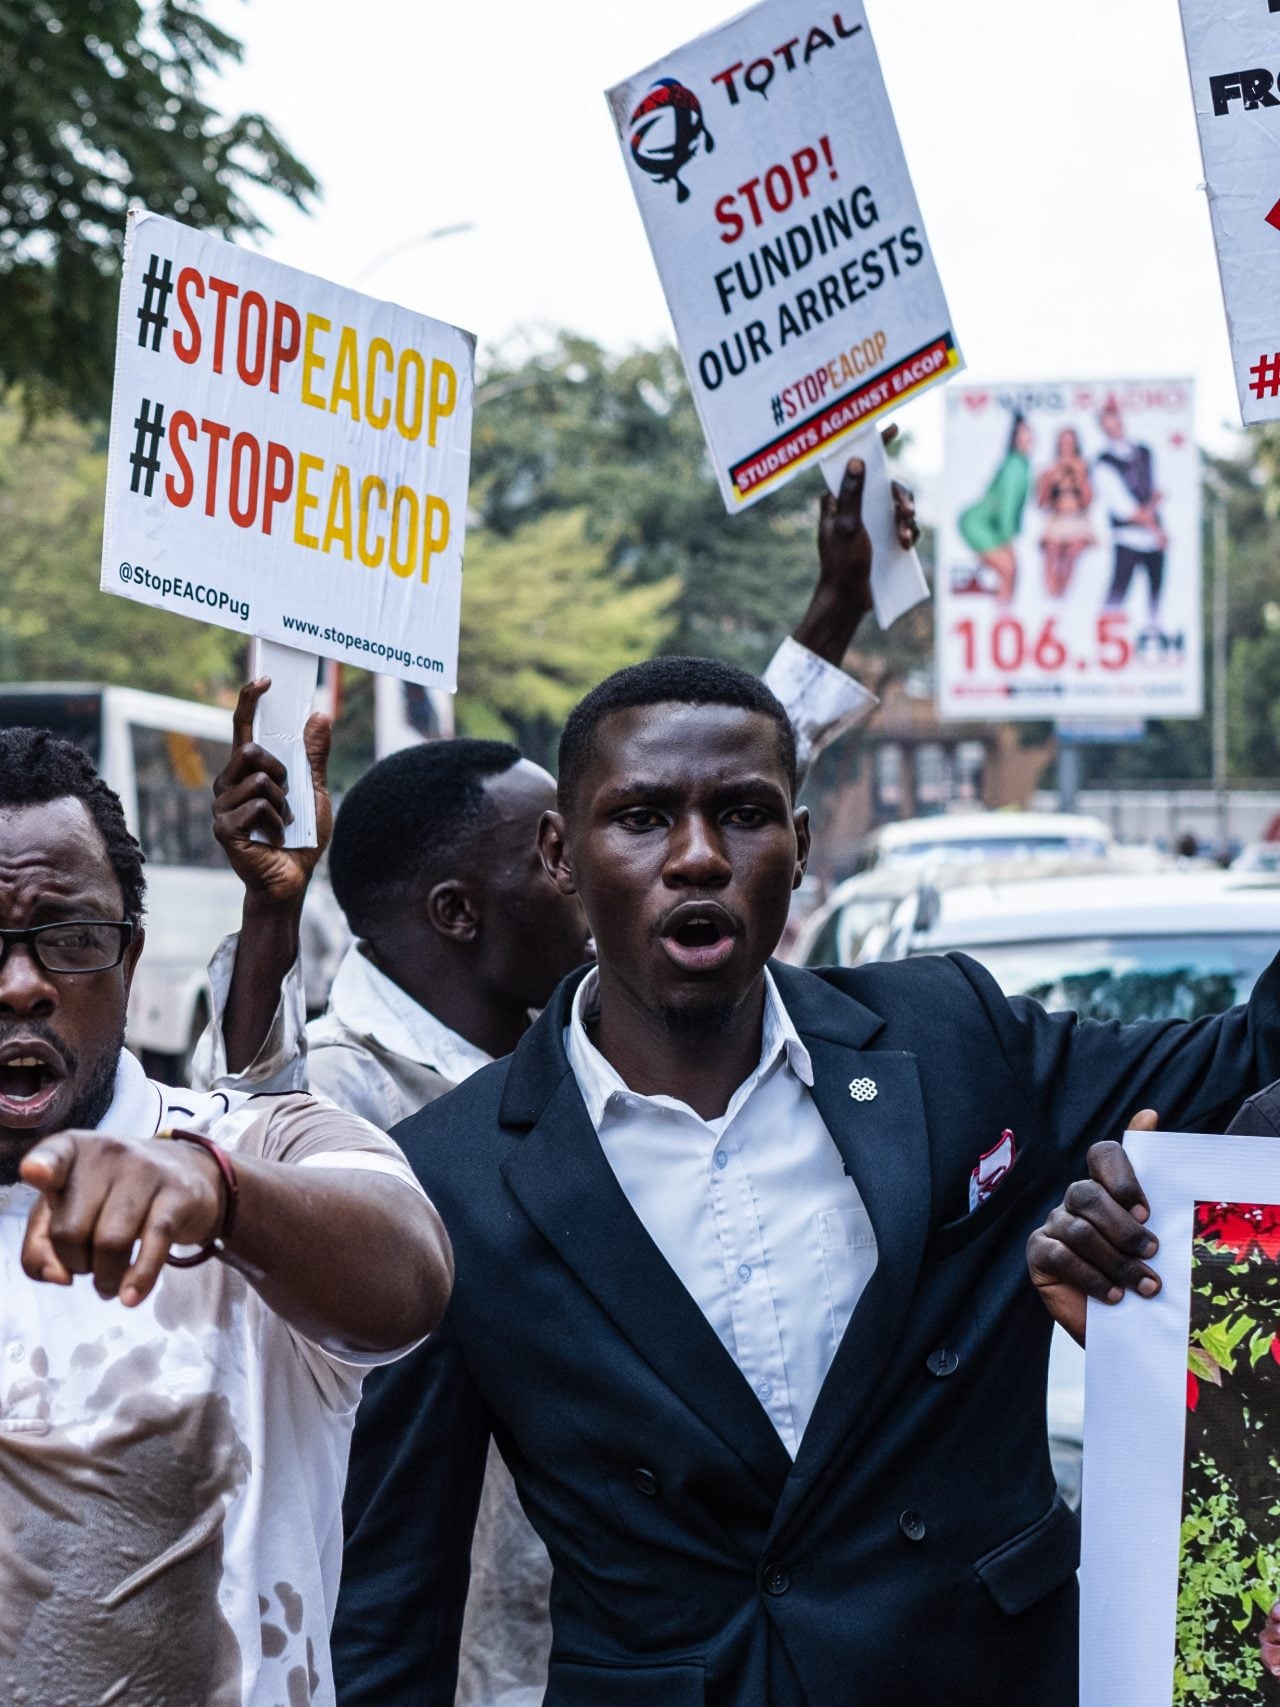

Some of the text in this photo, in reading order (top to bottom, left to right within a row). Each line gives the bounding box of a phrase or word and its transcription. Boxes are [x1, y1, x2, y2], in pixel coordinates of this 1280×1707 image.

[711, 14, 862, 105] TOTAL
[1209, 68, 1280, 117] FR
[714, 135, 839, 245] STOP!
[714, 185, 880, 315] FUNDING
[137, 254, 457, 448] #STOPEACOP
[698, 226, 924, 392] OUR ARRESTS
[736, 350, 946, 492] STUDENTS AGAINST EACOP
[771, 331, 888, 427] #STOPEACOP
[130, 398, 451, 585] #STOPEACOP
[119, 562, 251, 621] @StopEACOPug
[282, 614, 444, 673] www.stopeacopug.com
[953, 616, 1131, 672] 106.5
